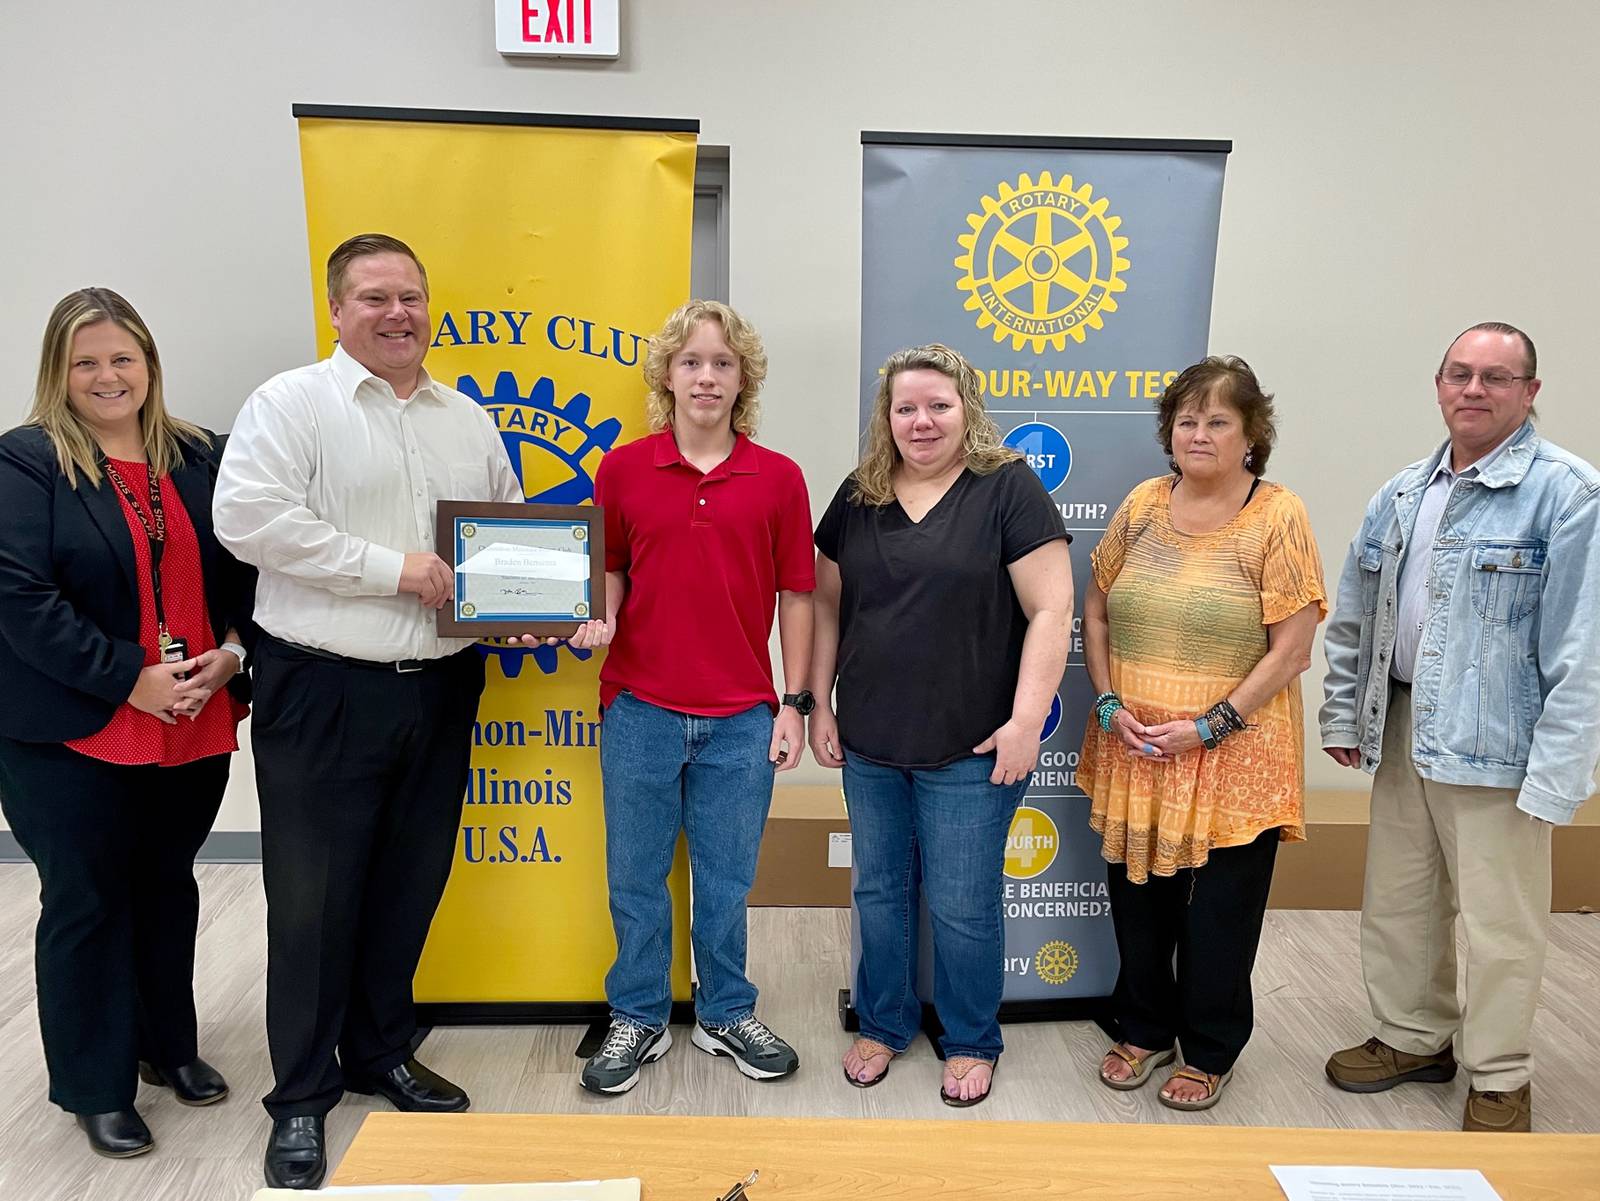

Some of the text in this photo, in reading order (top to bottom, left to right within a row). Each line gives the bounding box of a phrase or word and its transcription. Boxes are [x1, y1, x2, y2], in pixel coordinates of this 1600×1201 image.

[522, 0, 592, 43] EXIT
[1009, 191, 1080, 213] ROTARY
[981, 290, 1103, 334] INTERNATIONAL
[547, 315, 649, 366] CLU
[104, 463, 131, 495] MCHS
[153, 508, 165, 541] MCHS
[463, 826, 562, 864] U.S.A.
